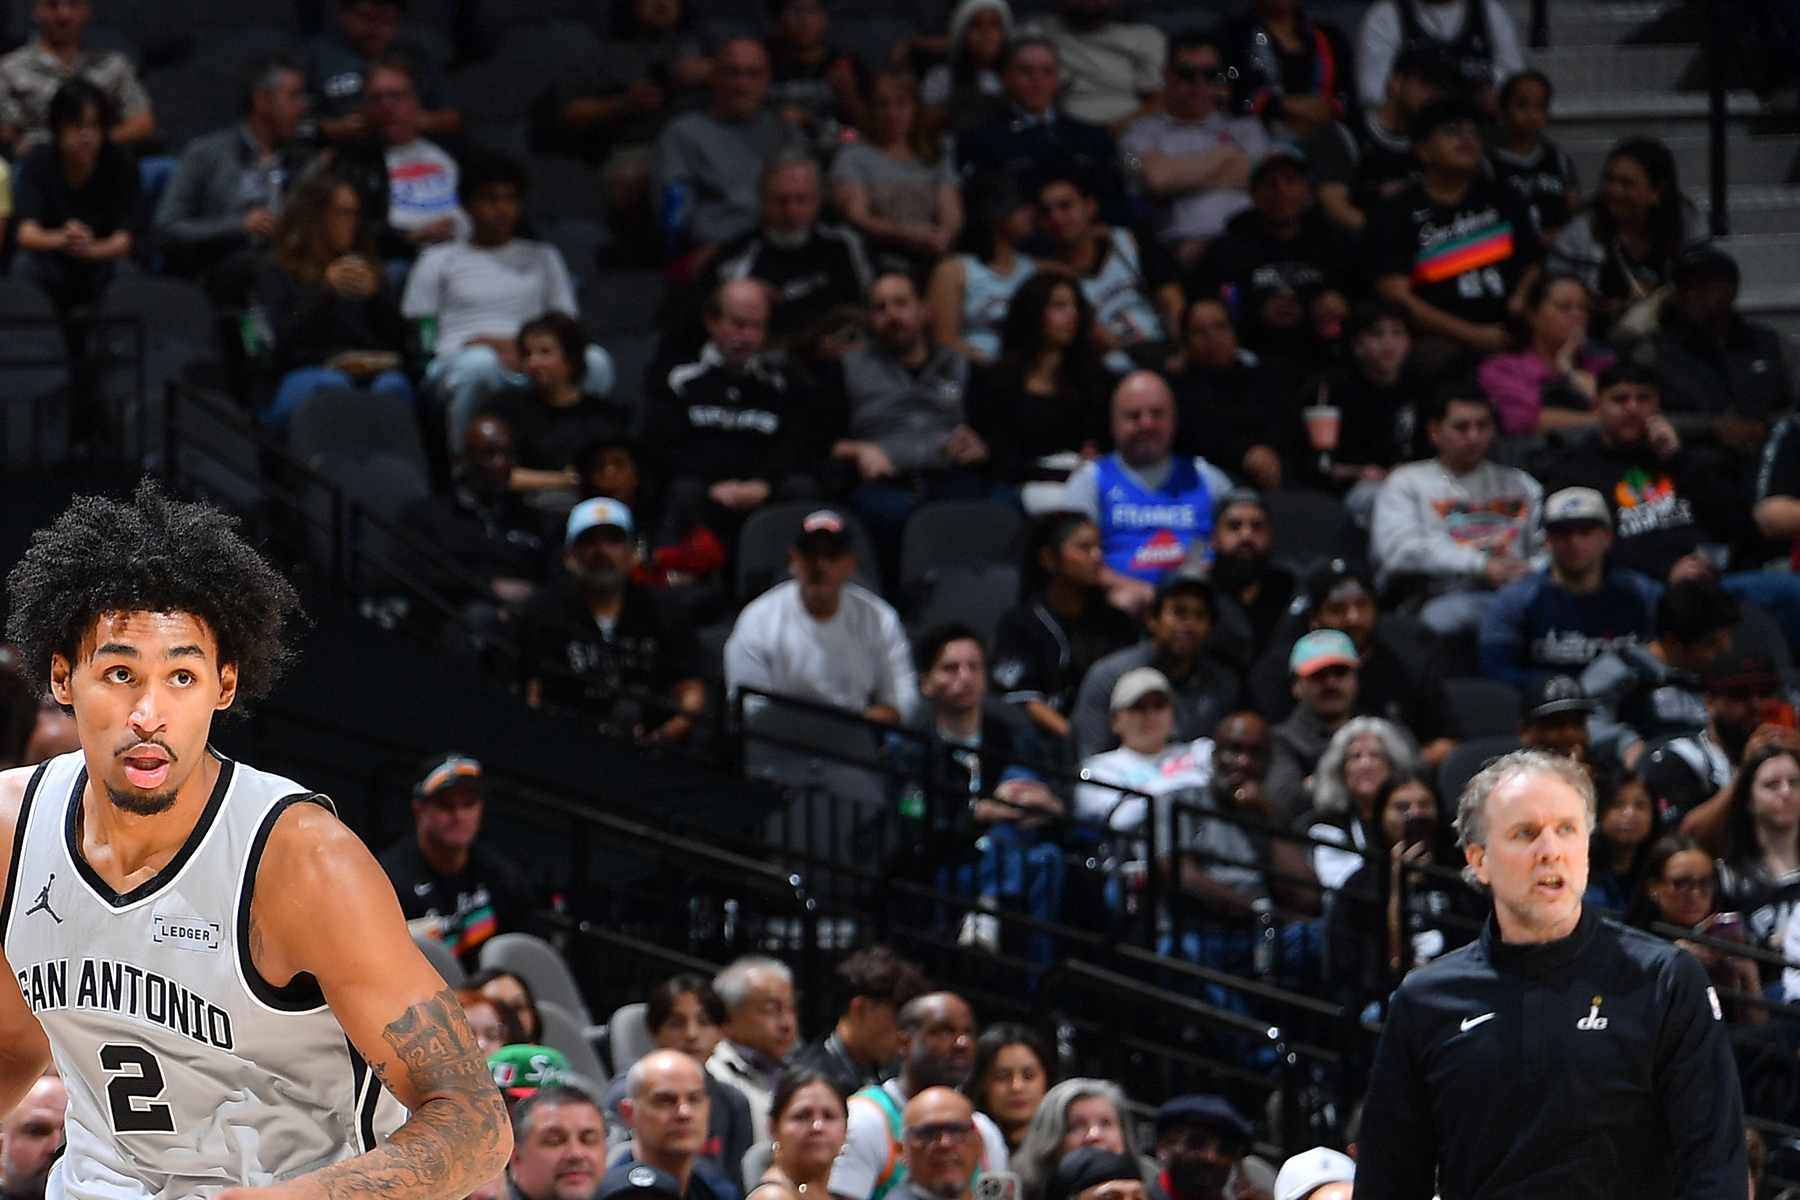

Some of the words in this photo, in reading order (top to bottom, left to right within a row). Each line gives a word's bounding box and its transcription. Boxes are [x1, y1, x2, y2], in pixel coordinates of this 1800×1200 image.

[1111, 503, 1195, 529] FRANCE
[161, 924, 211, 942] LEDGER
[75, 957, 235, 1051] ANTONIO
[97, 1042, 178, 1136] 2
